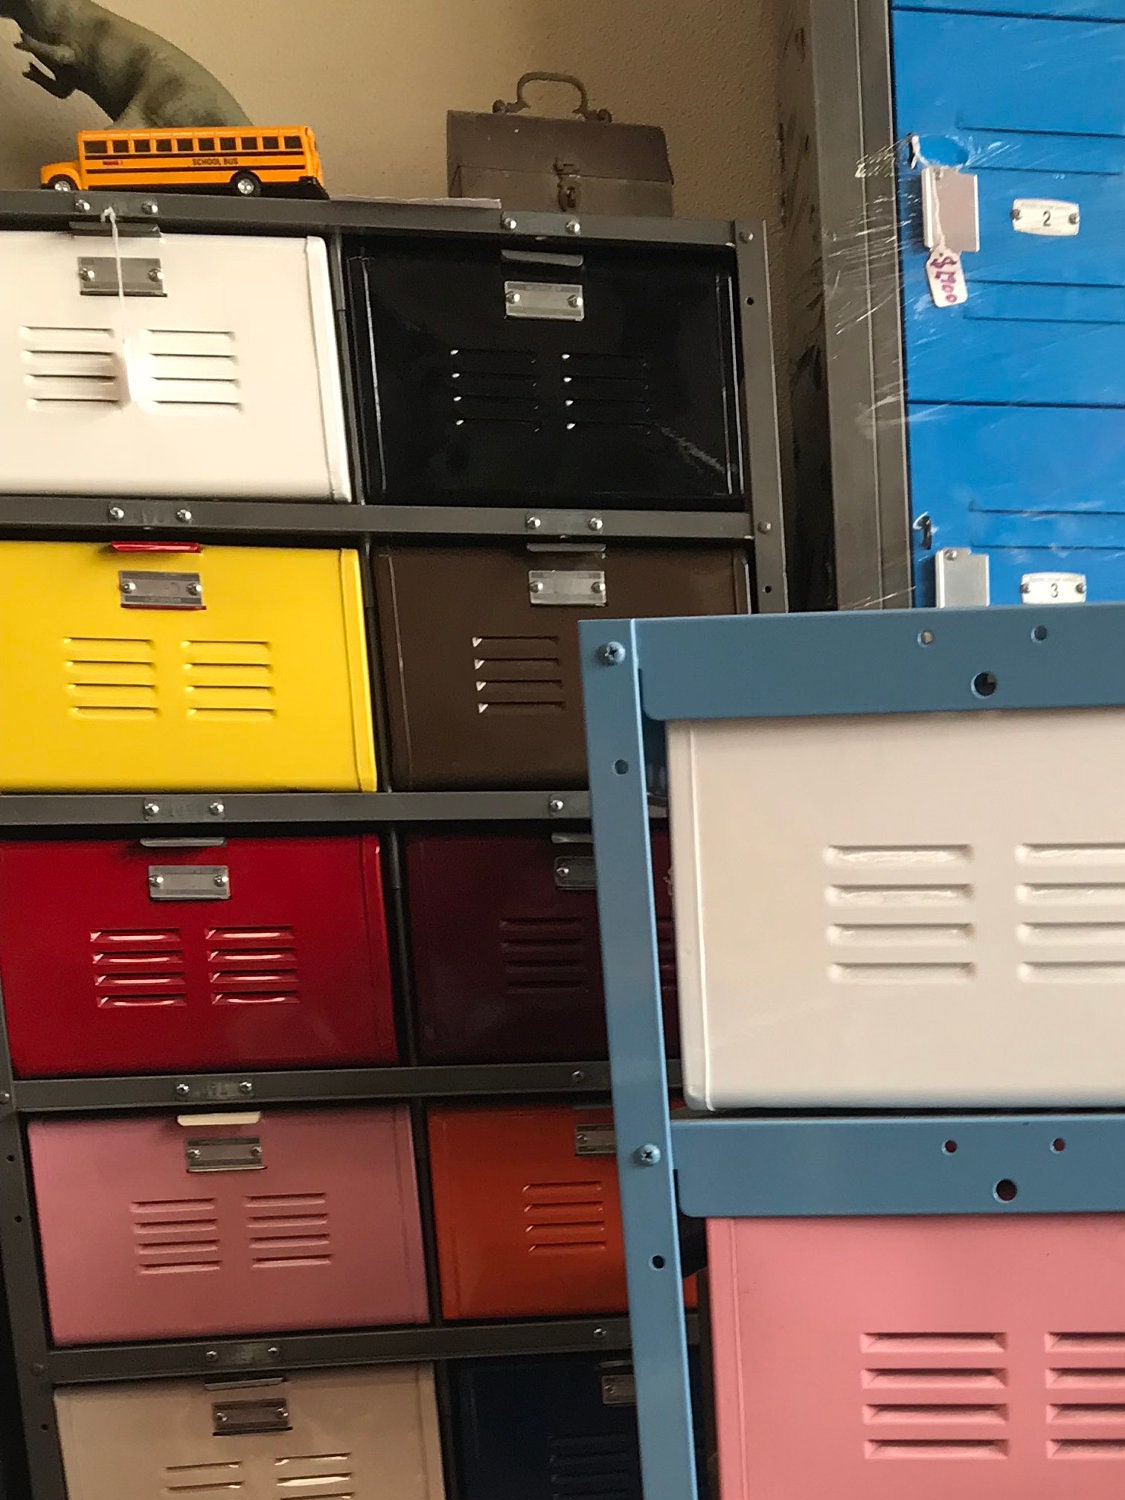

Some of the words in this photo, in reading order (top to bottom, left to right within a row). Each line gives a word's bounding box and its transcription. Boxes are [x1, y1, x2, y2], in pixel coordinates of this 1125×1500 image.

[192, 157, 221, 166] SCHOOL
[223, 157, 239, 166] BUS
[1042, 210, 1052, 227] 2
[1050, 582, 1060, 599] 3
